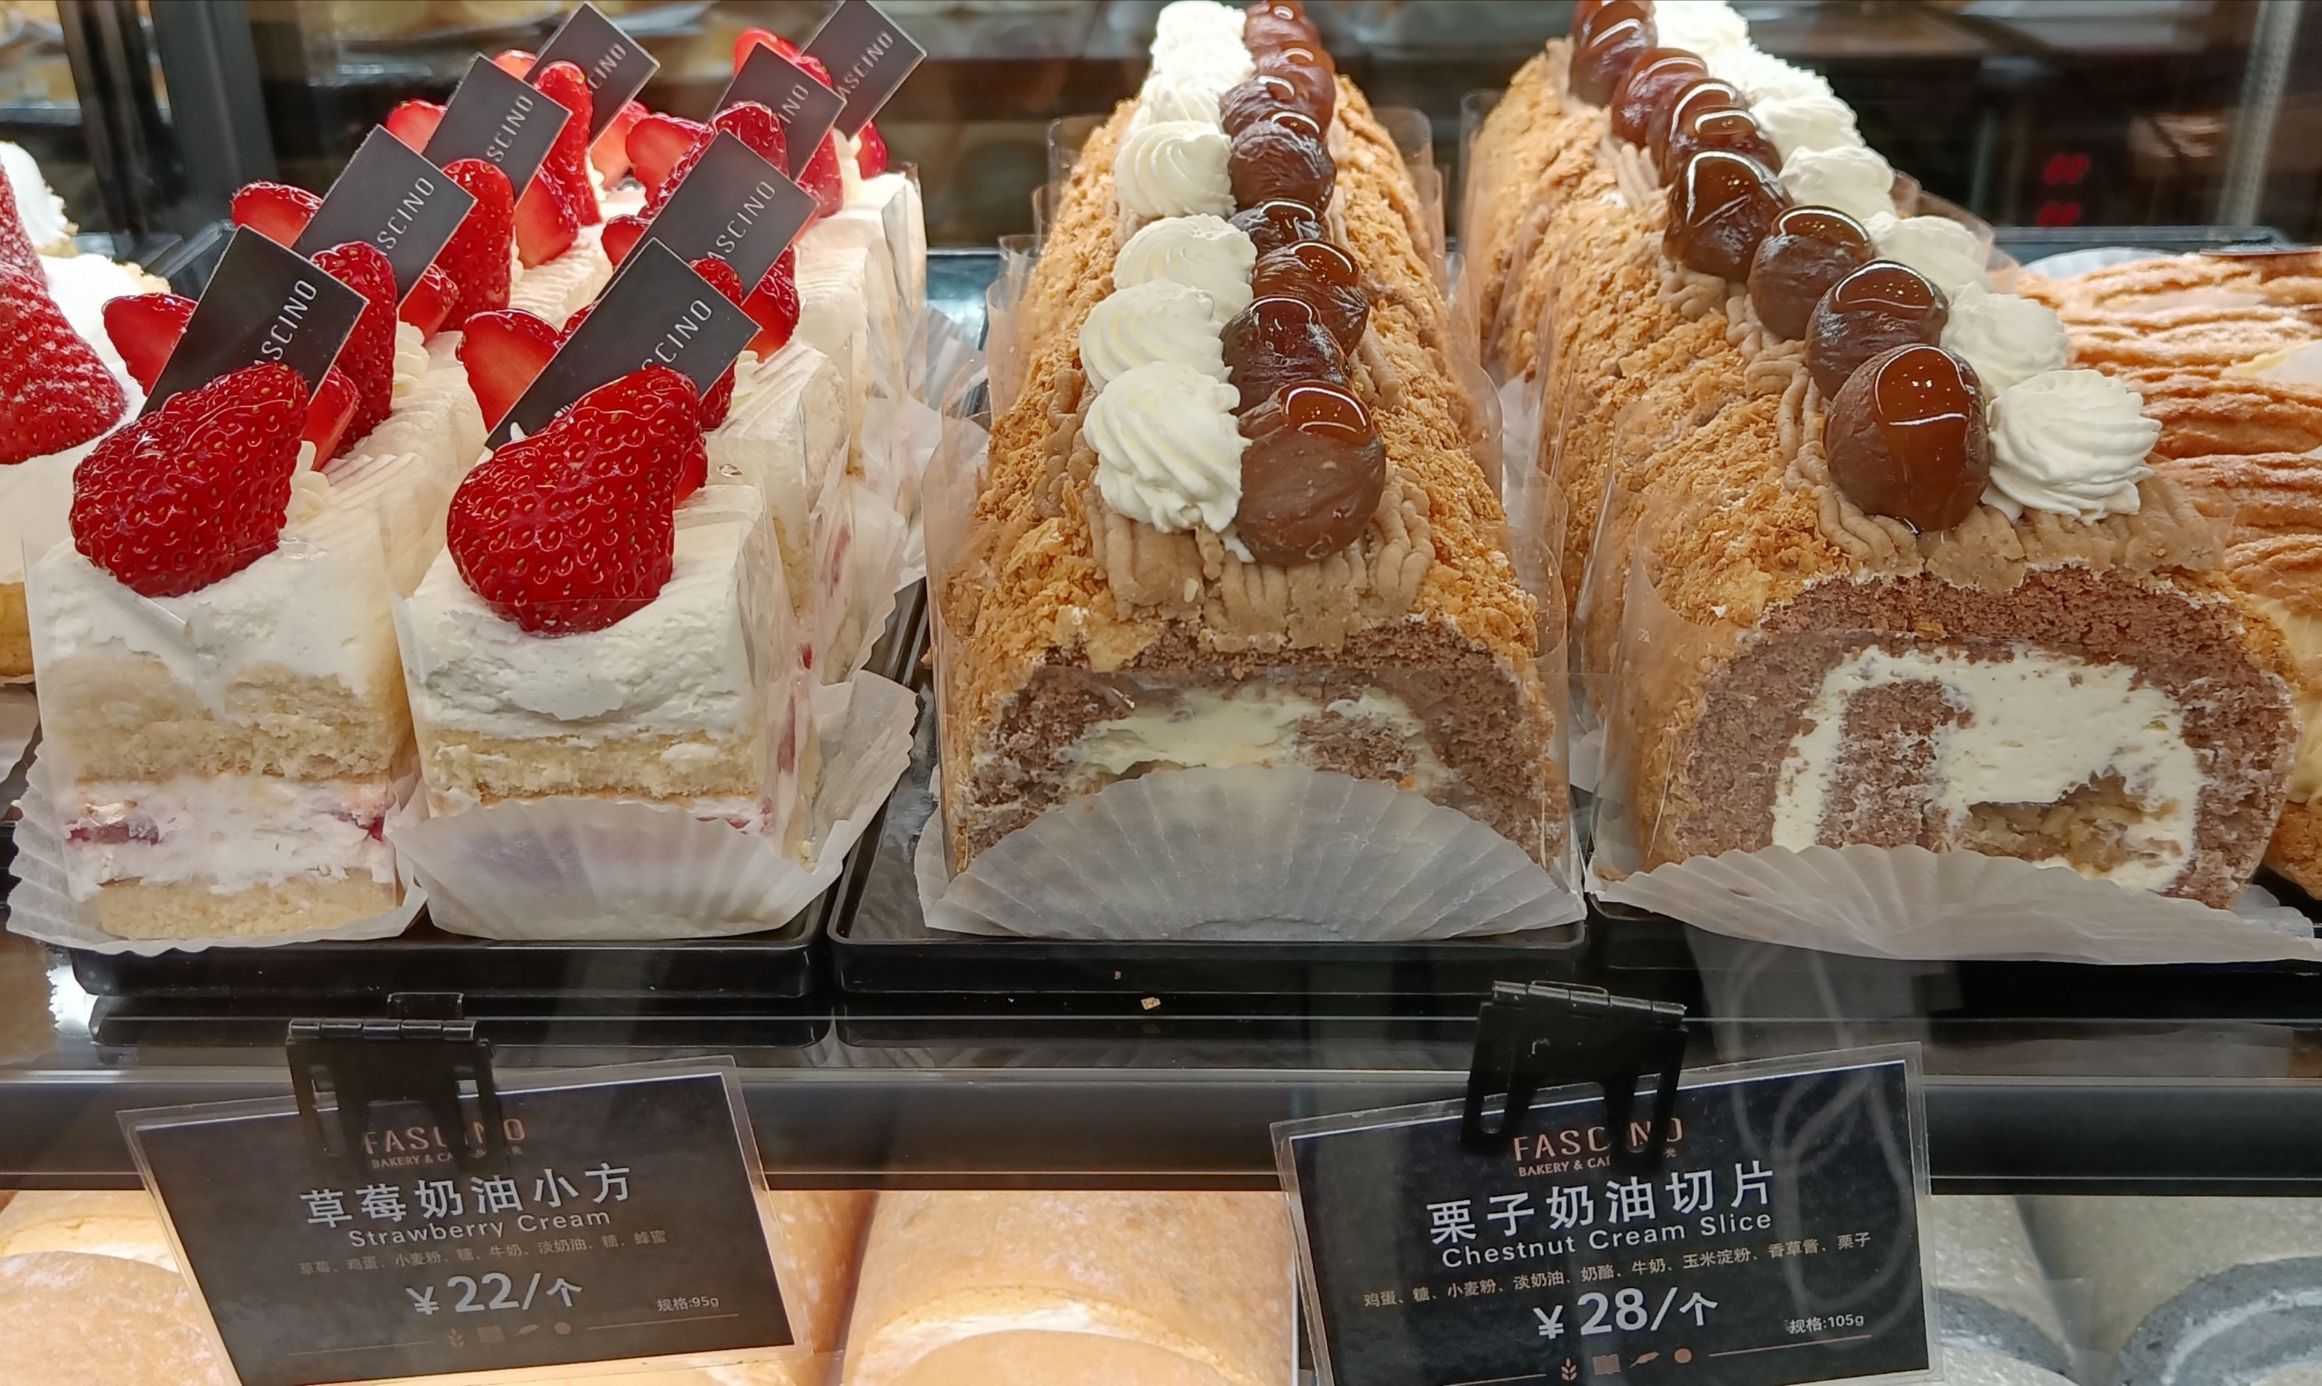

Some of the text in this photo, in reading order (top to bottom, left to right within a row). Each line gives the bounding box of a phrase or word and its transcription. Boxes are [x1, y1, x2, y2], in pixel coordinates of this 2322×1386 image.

[837, 31, 894, 99] ASCINO
[485, 94, 534, 163] SCINO
[376, 177, 435, 252] SCINO
[254, 280, 317, 364] SCINO
[371, 1154, 420, 1169] BAKERY
[425, 1154, 433, 1164] &
[1518, 1161, 1570, 1177] BAKERY
[1573, 1159, 1583, 1171] &
[300, 1162, 631, 1229] 草莓奶油小方
[349, 1211, 611, 1247] Strawberry Cream
[1426, 1160, 1773, 1245] 栗子奶油切片
[1442, 1212, 1772, 1268] Chestnut Cream Slice
